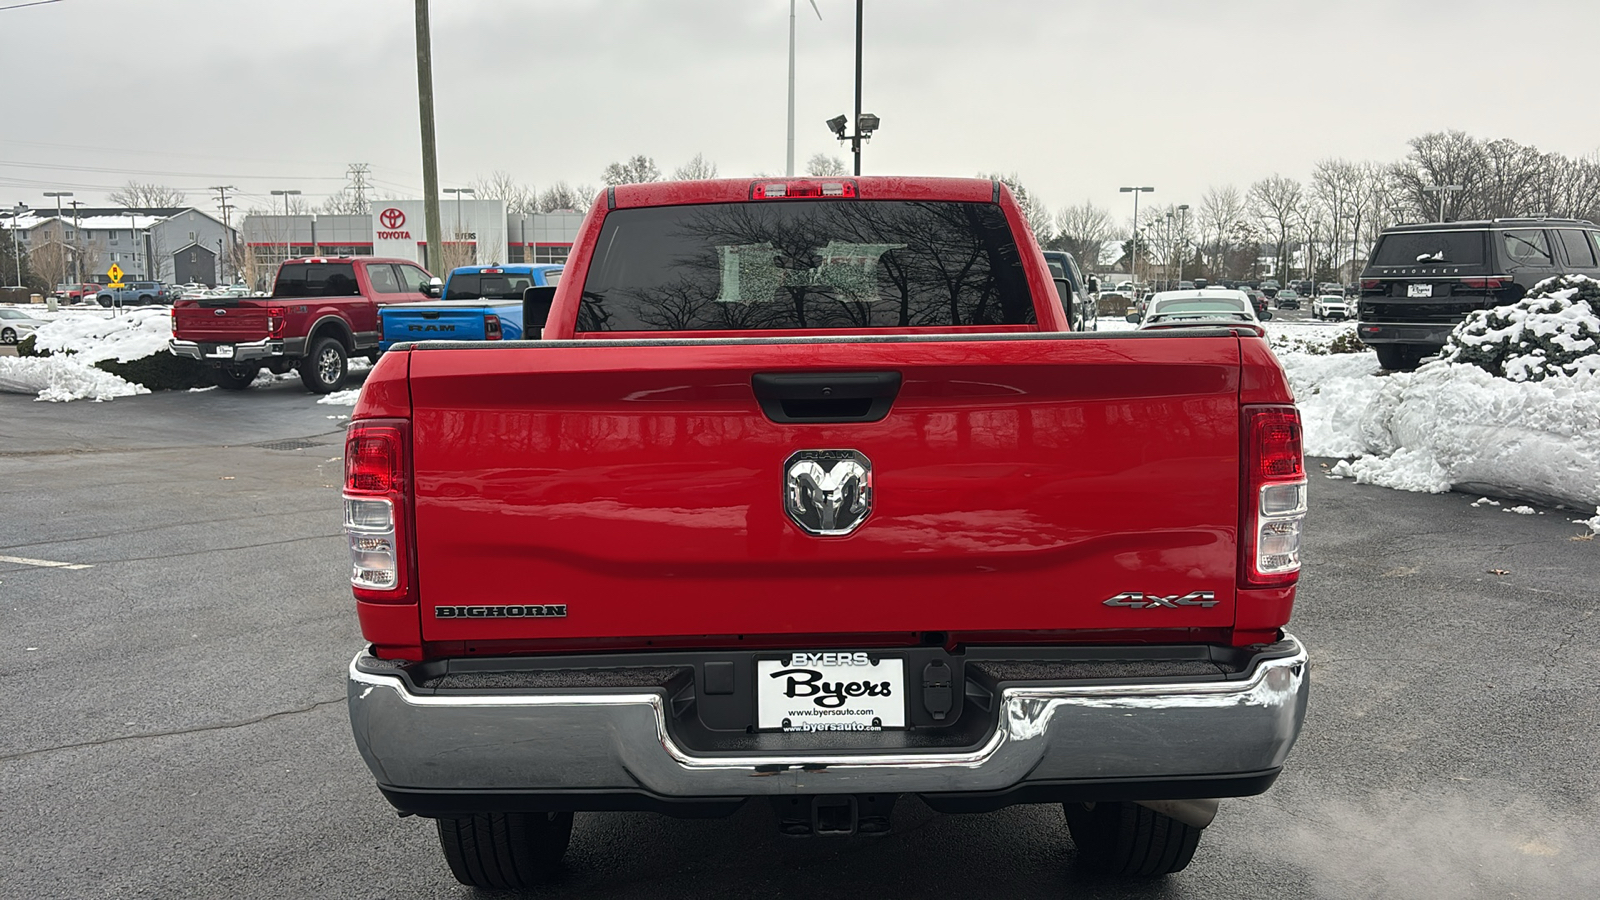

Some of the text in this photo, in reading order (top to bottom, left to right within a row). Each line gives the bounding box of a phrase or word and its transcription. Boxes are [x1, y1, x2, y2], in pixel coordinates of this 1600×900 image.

[377, 231, 411, 240] TOYOTA
[408, 324, 456, 332] RAM
[801, 451, 855, 459] RAM
[434, 604, 567, 619] BIGHORN
[792, 652, 869, 667] BYERS
[769, 668, 892, 708] Byers
[788, 708, 874, 718] www.byersauto.com
[783, 721, 882, 733] www.byersauto.com
